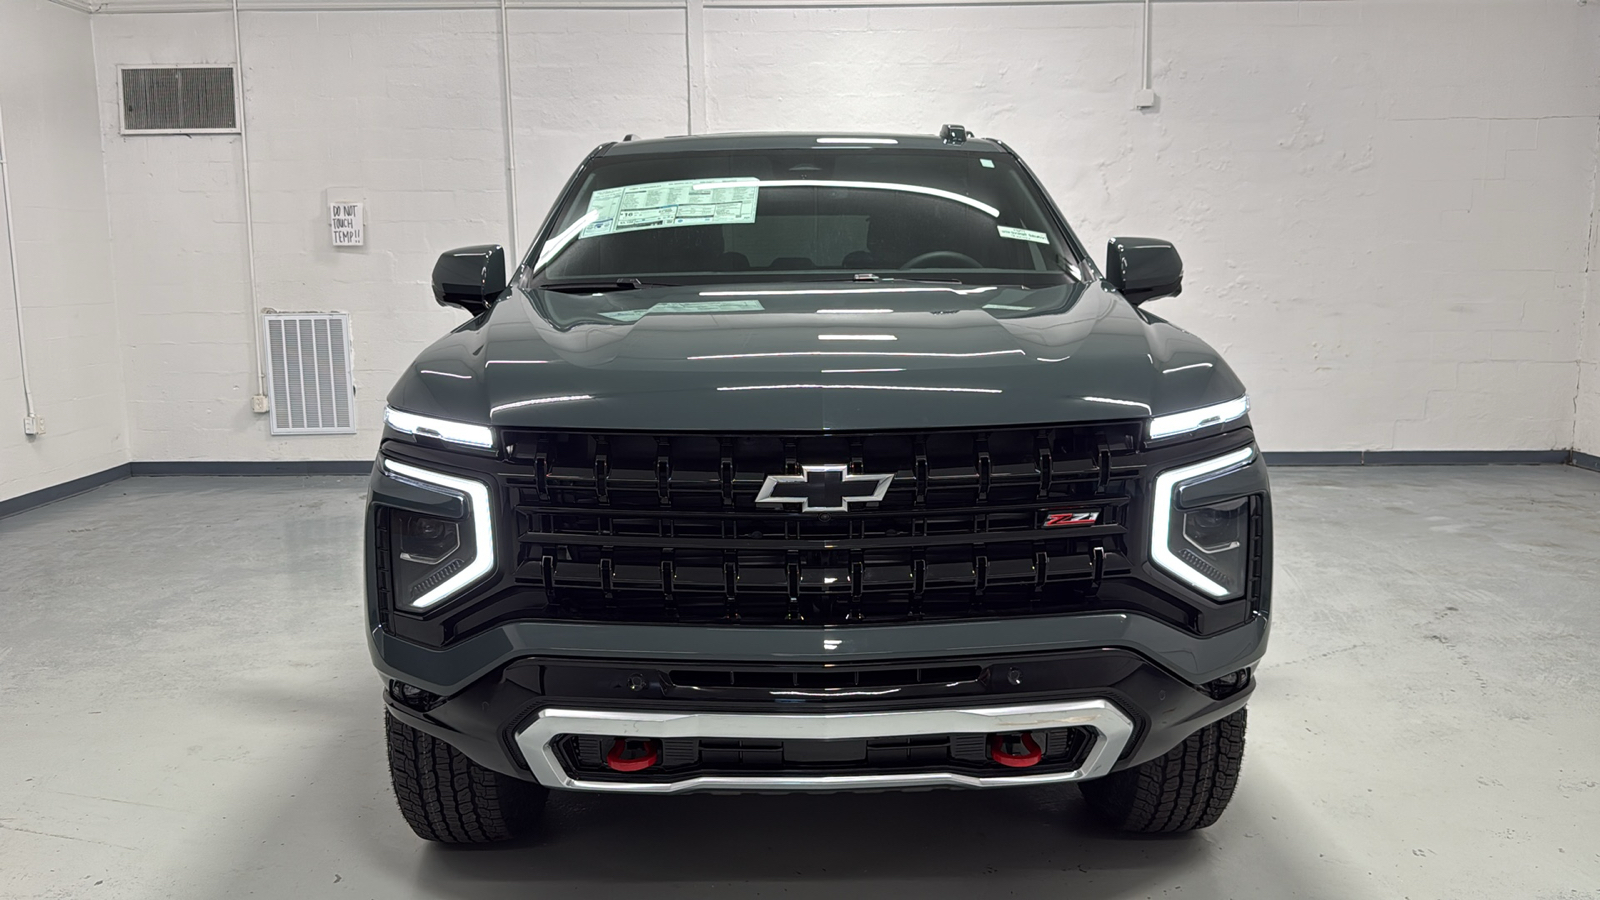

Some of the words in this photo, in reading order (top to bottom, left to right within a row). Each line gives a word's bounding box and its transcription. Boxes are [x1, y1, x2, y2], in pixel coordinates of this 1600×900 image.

[333, 205, 341, 217] DO
[343, 205, 358, 217] NOT
[333, 218, 353, 229] TOUCH
[333, 229, 360, 243] TEMP!!
[1043, 512, 1099, 526] Z71
